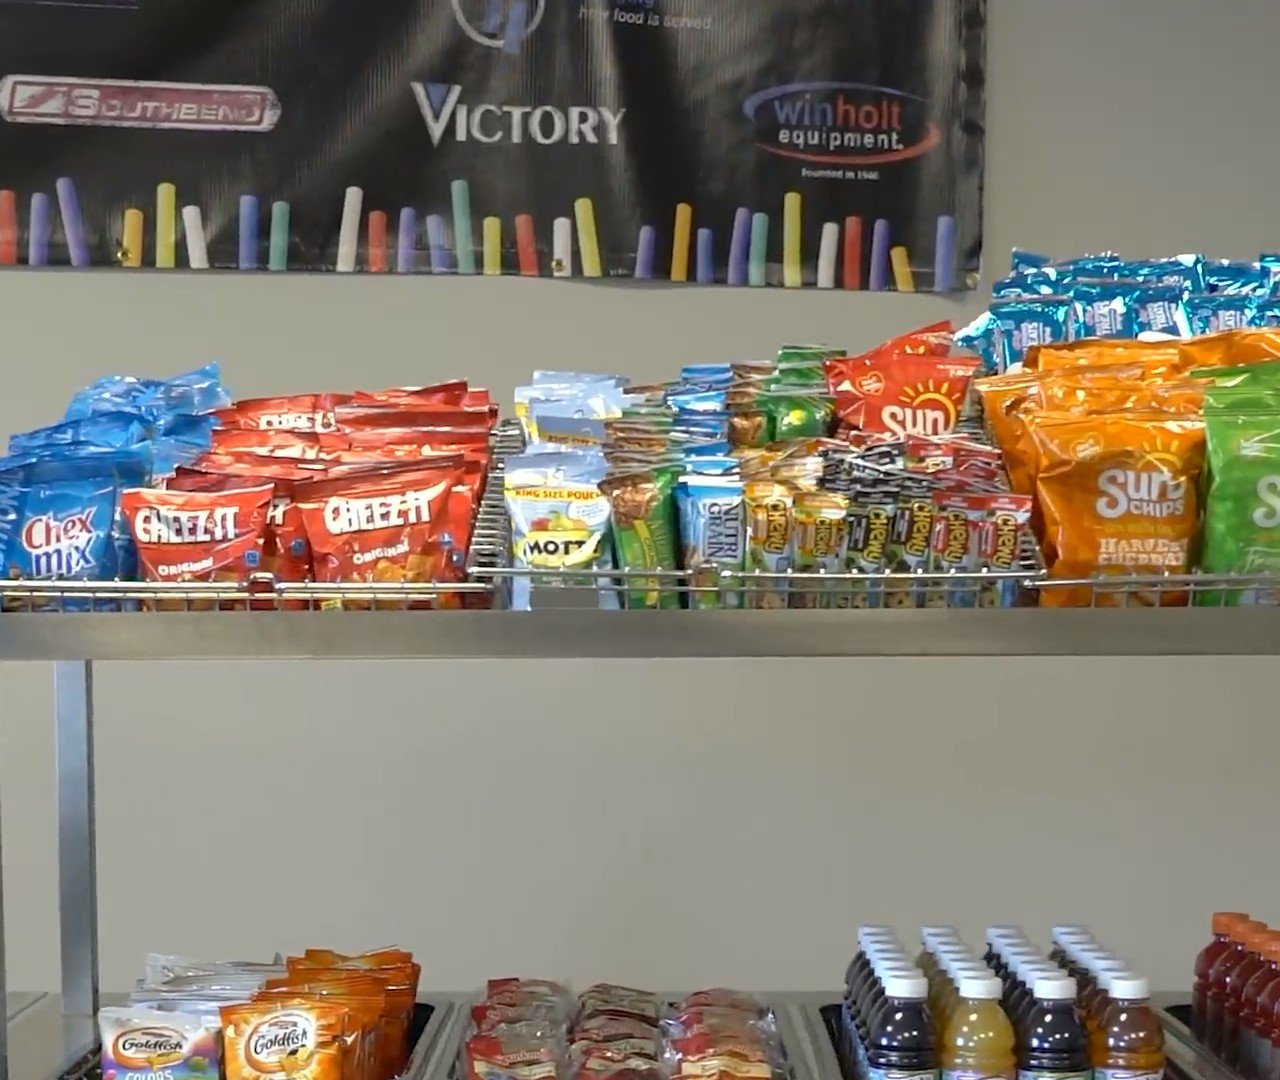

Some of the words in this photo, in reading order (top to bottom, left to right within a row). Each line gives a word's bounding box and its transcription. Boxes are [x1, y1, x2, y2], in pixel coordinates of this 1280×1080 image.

[613, 8, 645, 24] food
[647, 11, 660, 26] is
[663, 16, 712, 29] served
[410, 82, 626, 147] VICTORY
[773, 94, 902, 129] winholt
[881, 404, 946, 438] Sun
[515, 488, 540, 499] KING
[542, 489, 565, 499] SIZE
[1096, 468, 1187, 518] Sun
[1129, 499, 1185, 517] CHIPS
[24, 509, 94, 550] Chex
[707, 502, 723, 559] GRAIN
[722, 502, 740, 559] NUTRI
[121, 1035, 184, 1052] Goldfish
[254, 1028, 308, 1055] Goldfish
